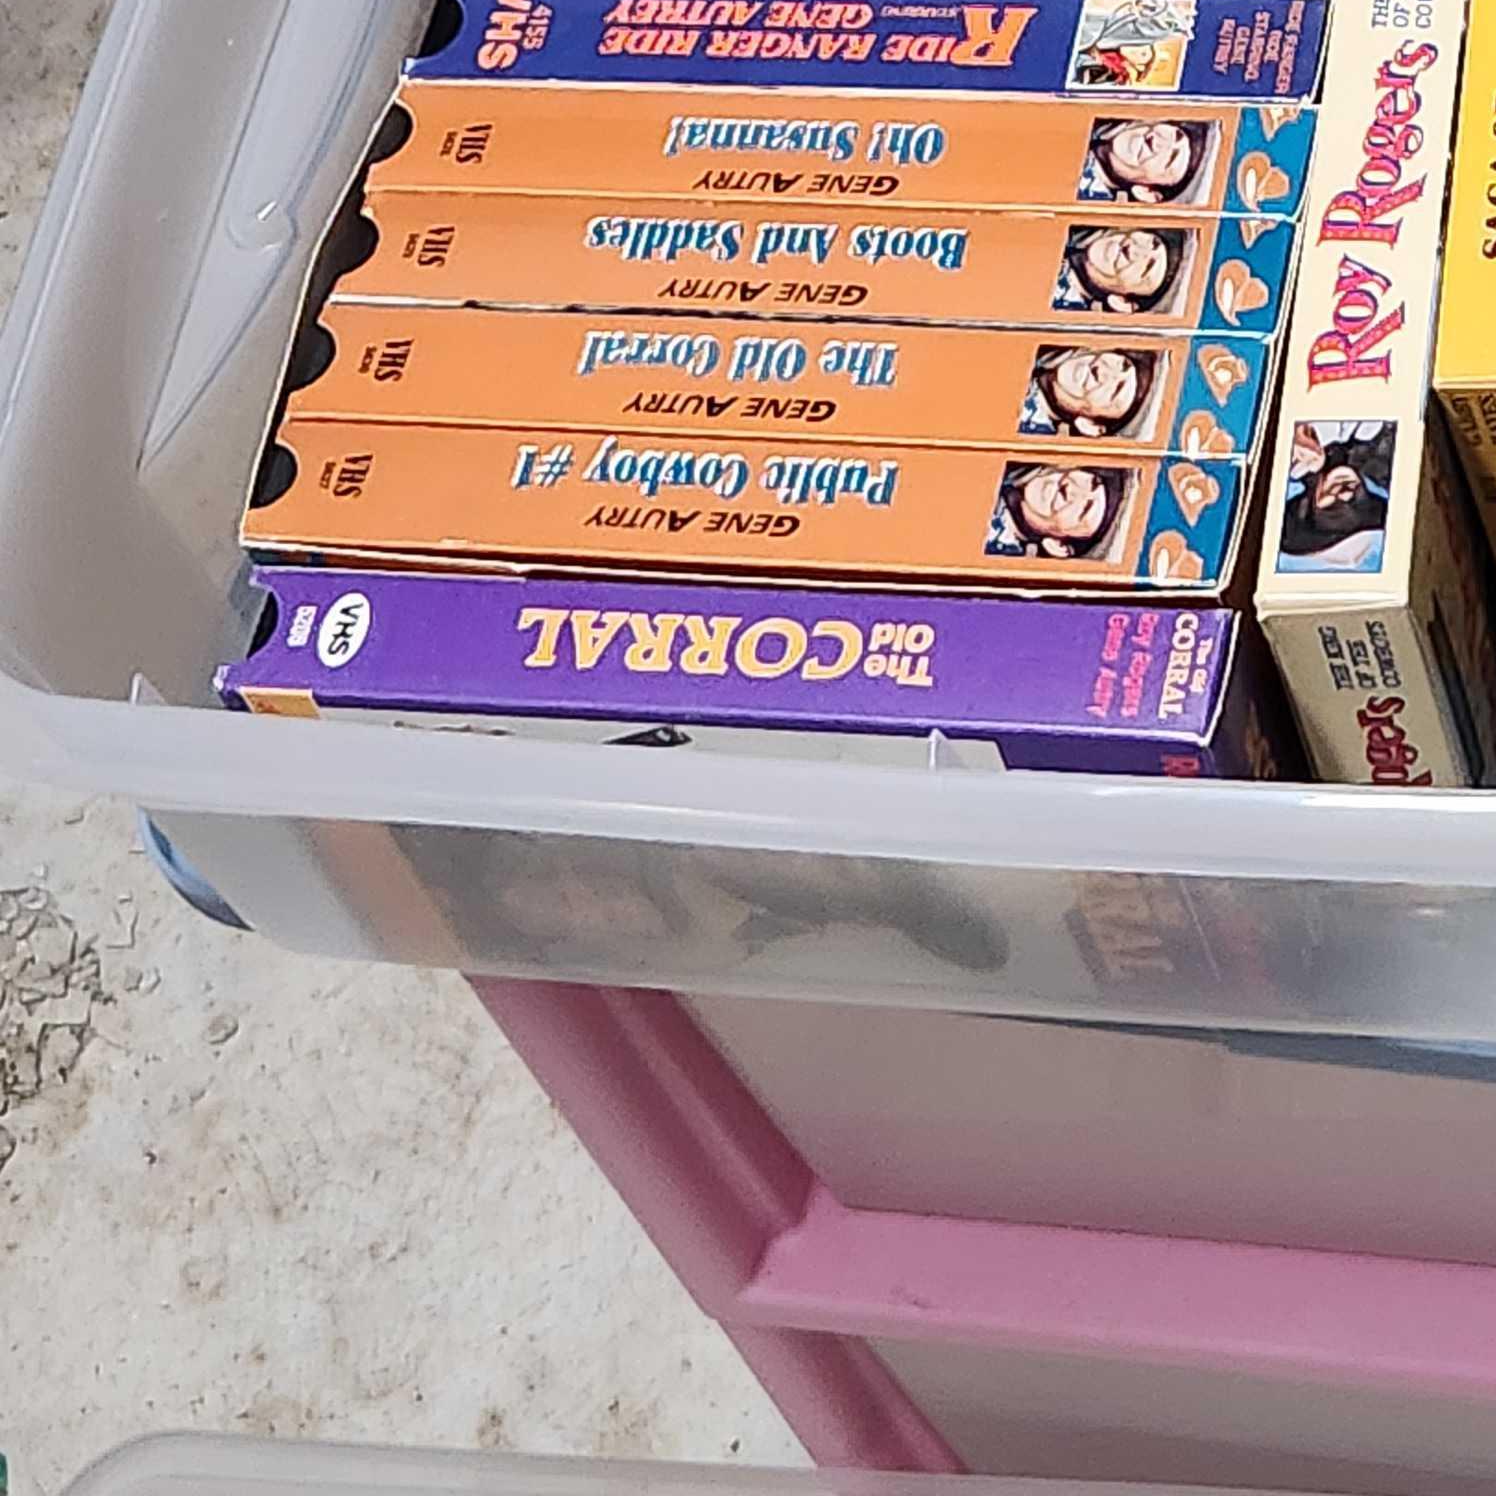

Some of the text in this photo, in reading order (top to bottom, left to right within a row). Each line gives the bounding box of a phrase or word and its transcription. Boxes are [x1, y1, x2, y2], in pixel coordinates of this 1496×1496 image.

[597, 3, 1039, 68] RIDE RANGER RIDE
[1393, 3, 1412, 29] OF
[454, 123, 494, 165] VHS
[663, 115, 946, 166] Oh! Susanna!
[691, 169, 901, 197] GENE AUTRY
[1306, 38, 1440, 393] Roy Rogers
[416, 225, 456, 267] VHS
[585, 215, 969, 271] Boots And Saddles
[658, 277, 869, 307] GENE AUTRY
[374, 338, 414, 383] VHS
[577, 329, 899, 387] The Old Corral
[622, 391, 838, 422] GENE AUTRY
[332, 453, 374, 499] VHS
[510, 434, 901, 507] Public Cowboy #1
[584, 505, 802, 538] GENE AUTRY
[327, 603, 364, 657] VHS
[514, 607, 864, 681] CORRAL
[868, 623, 936, 654] Old
[863, 654, 934, 687] The
[1157, 613, 1201, 722] CORRAL
